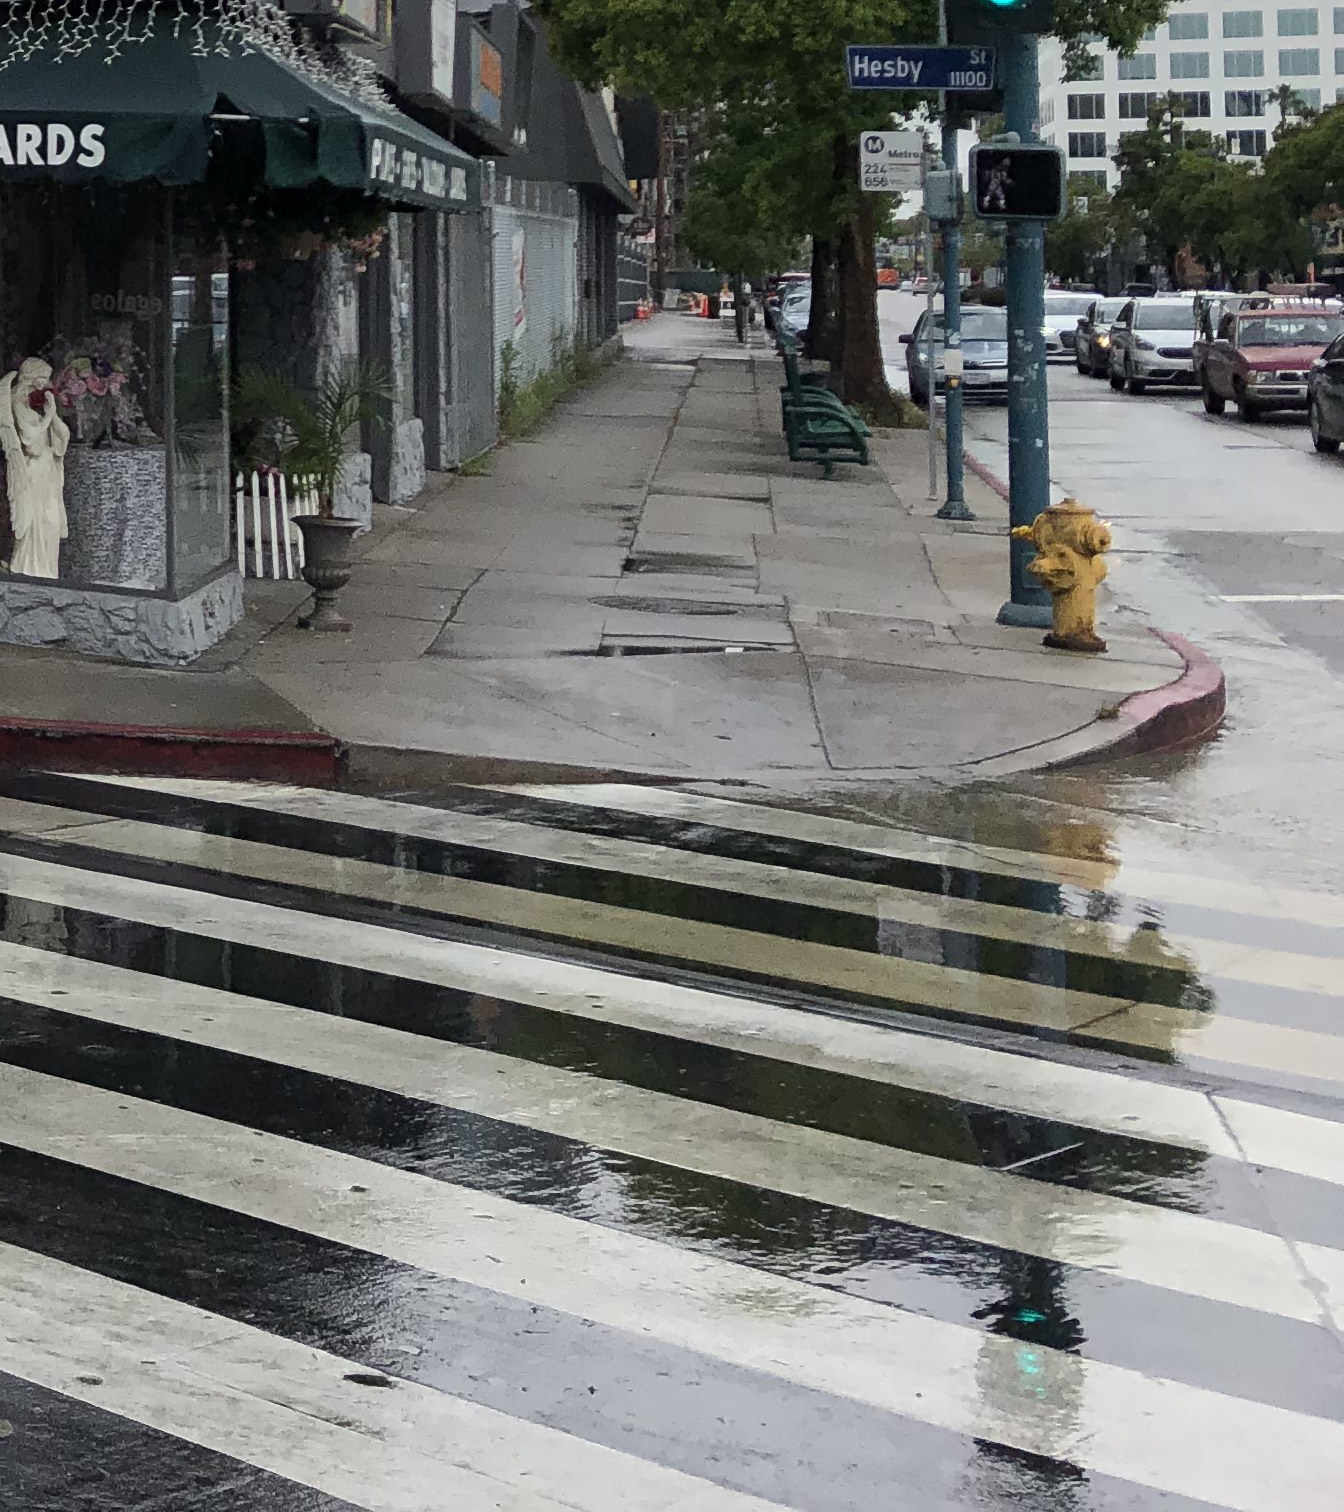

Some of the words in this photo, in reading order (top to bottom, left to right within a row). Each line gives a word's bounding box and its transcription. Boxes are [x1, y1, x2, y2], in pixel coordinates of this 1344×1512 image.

[853, 55, 923, 83] Hesby
[970, 49, 987, 65] St
[949, 71, 987, 87] 11100
[888, 149, 921, 159] Metro
[864, 163, 888, 174] 224
